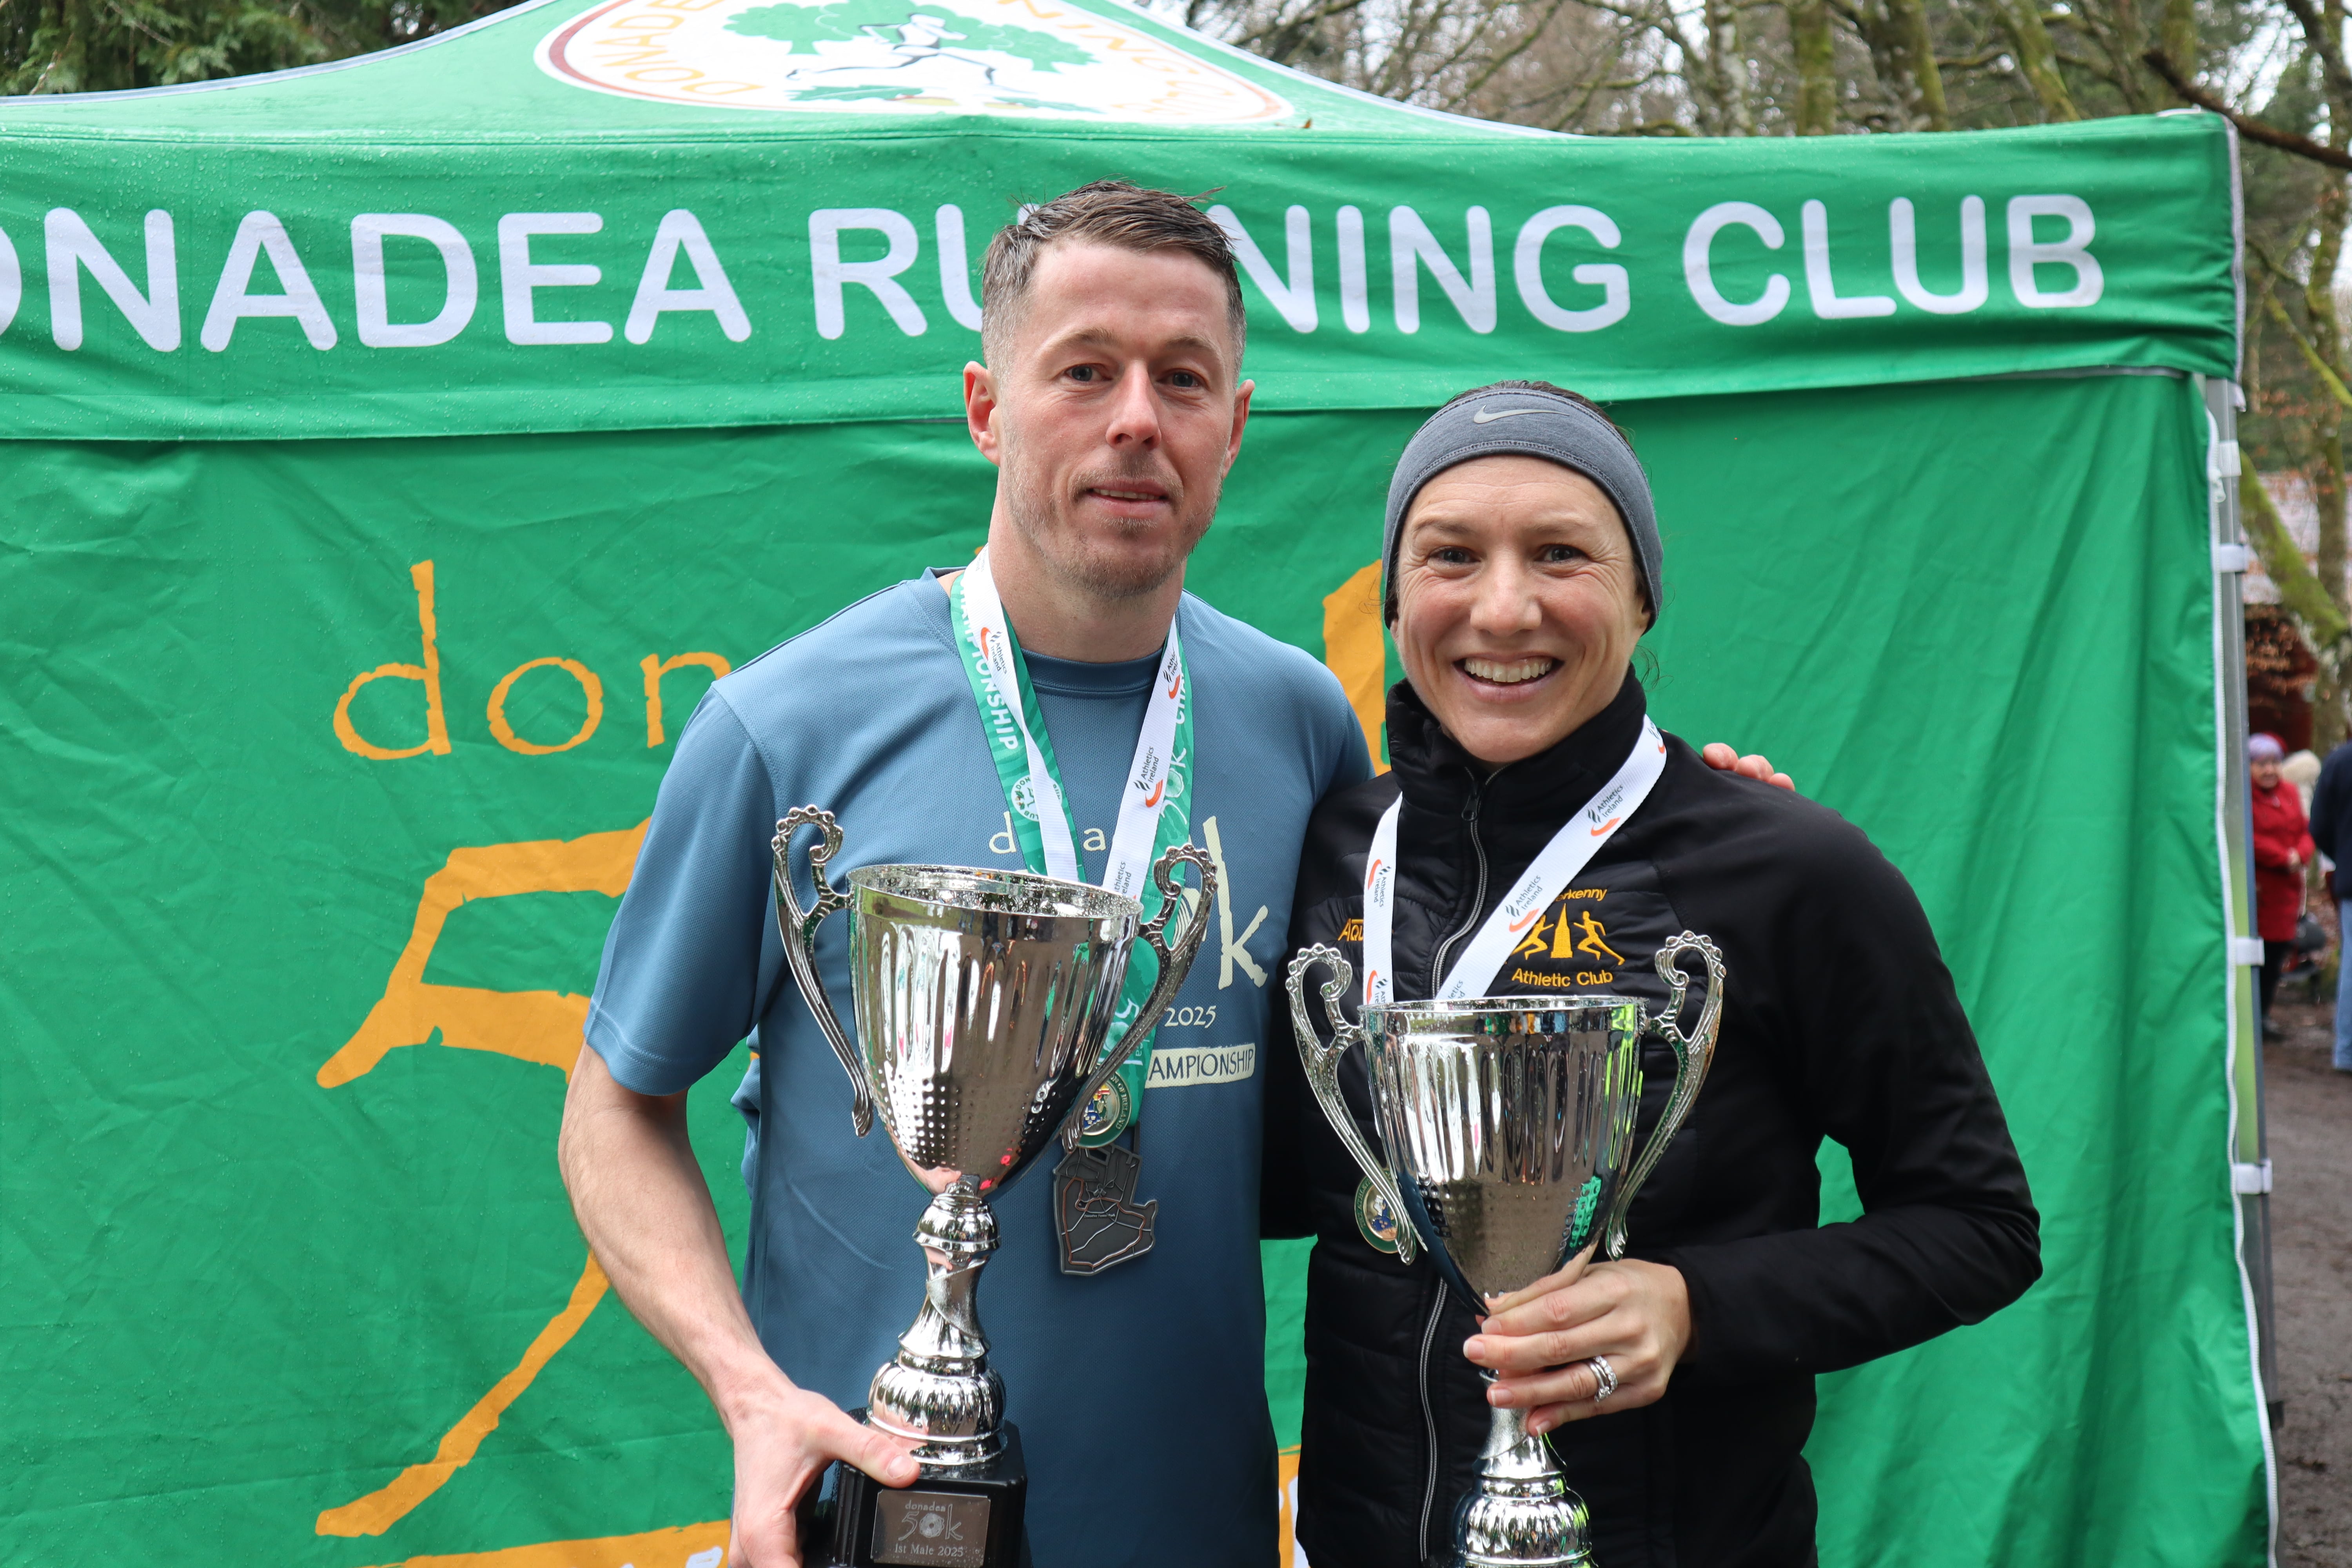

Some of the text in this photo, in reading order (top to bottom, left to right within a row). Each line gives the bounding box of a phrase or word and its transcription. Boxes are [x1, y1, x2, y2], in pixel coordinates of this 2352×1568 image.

[592, 0, 766, 95] DONADE
[0, 194, 2105, 353] NADEA RUNING CLUB
[991, 645, 1002, 671] Ireland
[1141, 746, 1154, 780] Athletics
[1148, 757, 1159, 783] Ireland
[1597, 784, 1624, 813] Athletics
[1602, 795, 1623, 817] Ireland
[1024, 811, 1039, 820] LUB
[1114, 861, 1126, 892] thletics
[1122, 871, 1132, 894] eland
[1515, 875, 1541, 906] Athletics
[1521, 886, 1543, 910] Ireland
[1555, 889, 1608, 902] erkenny
[1447, 980, 1463, 999] letics
[1512, 968, 1613, 987] Athletic Club
[1165, 1005, 1216, 1029] 2025
[1149, 1049, 1254, 1081] AMPIONSHIP
[1116, 1094, 1128, 1129] IRELAND
[905, 1499, 946, 1512] donadea
[895, 1543, 964, 1557] 1st Male 2025
